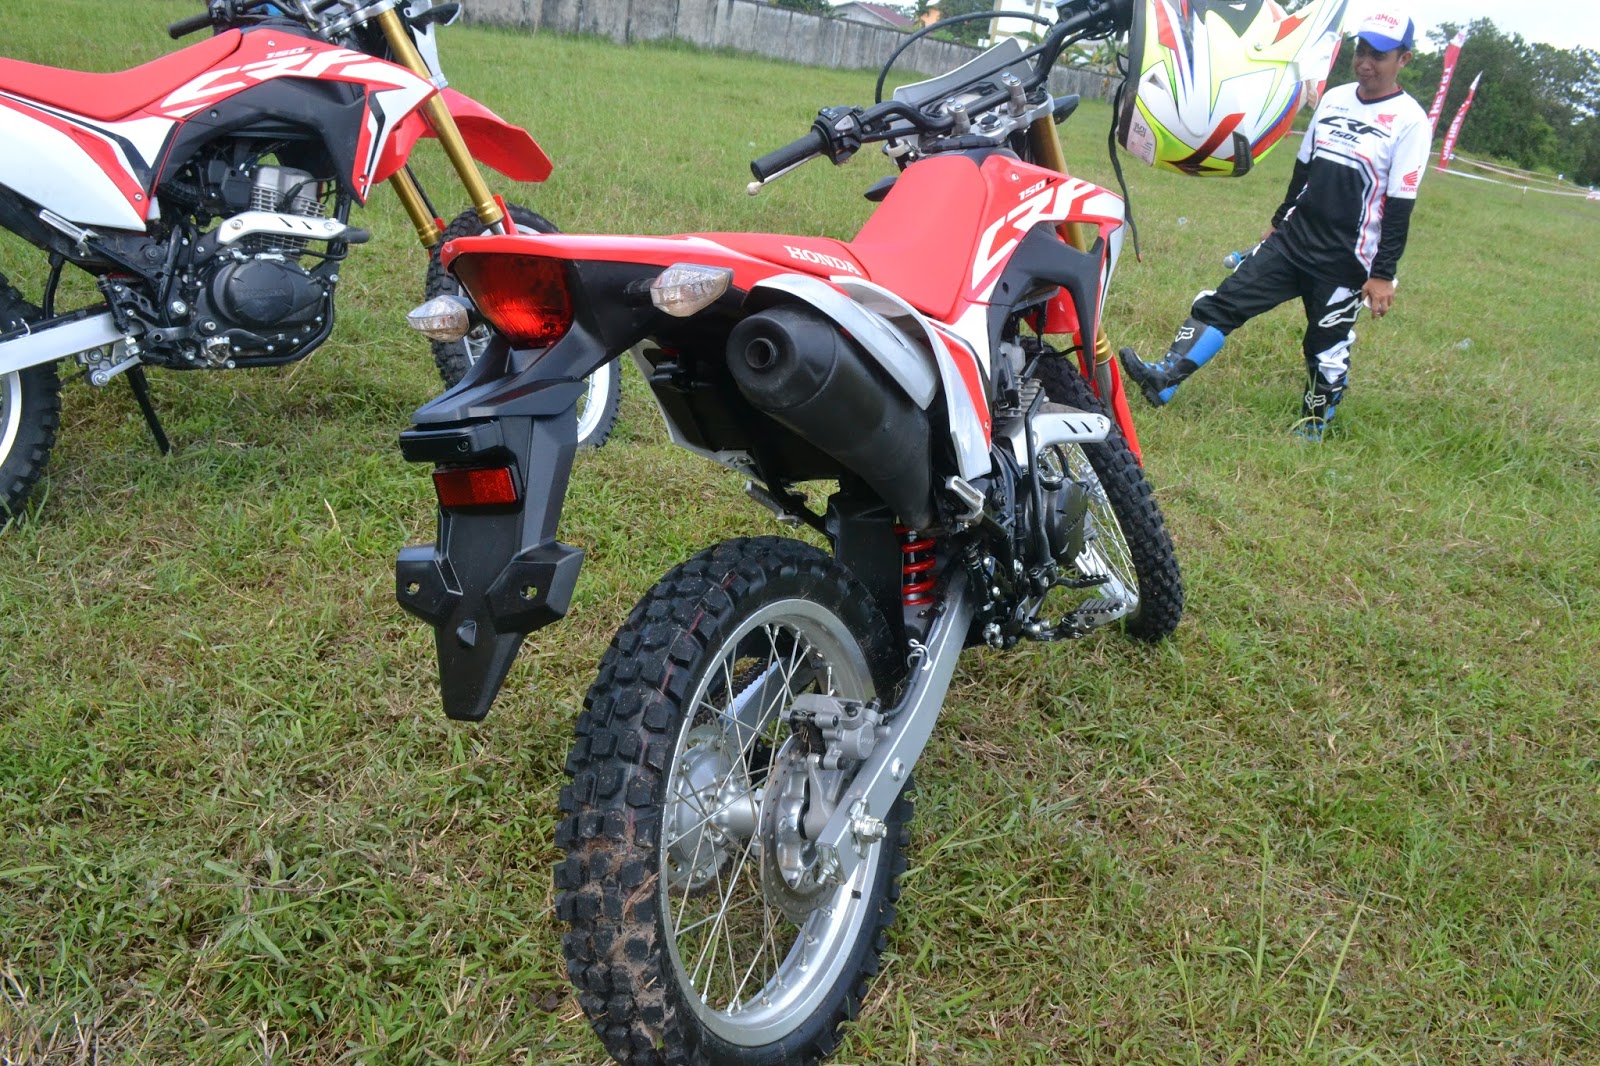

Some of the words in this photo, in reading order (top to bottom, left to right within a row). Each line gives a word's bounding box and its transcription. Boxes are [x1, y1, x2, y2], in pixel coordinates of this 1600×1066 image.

[266, 46, 320, 60] 150L
[160, 49, 372, 108] CRF
[1318, 116, 1391, 138] CRF
[1329, 130, 1361, 144] 150L
[1018, 177, 1057, 200] 150L
[972, 177, 1096, 291] CRF
[783, 245, 862, 276] HONDA
